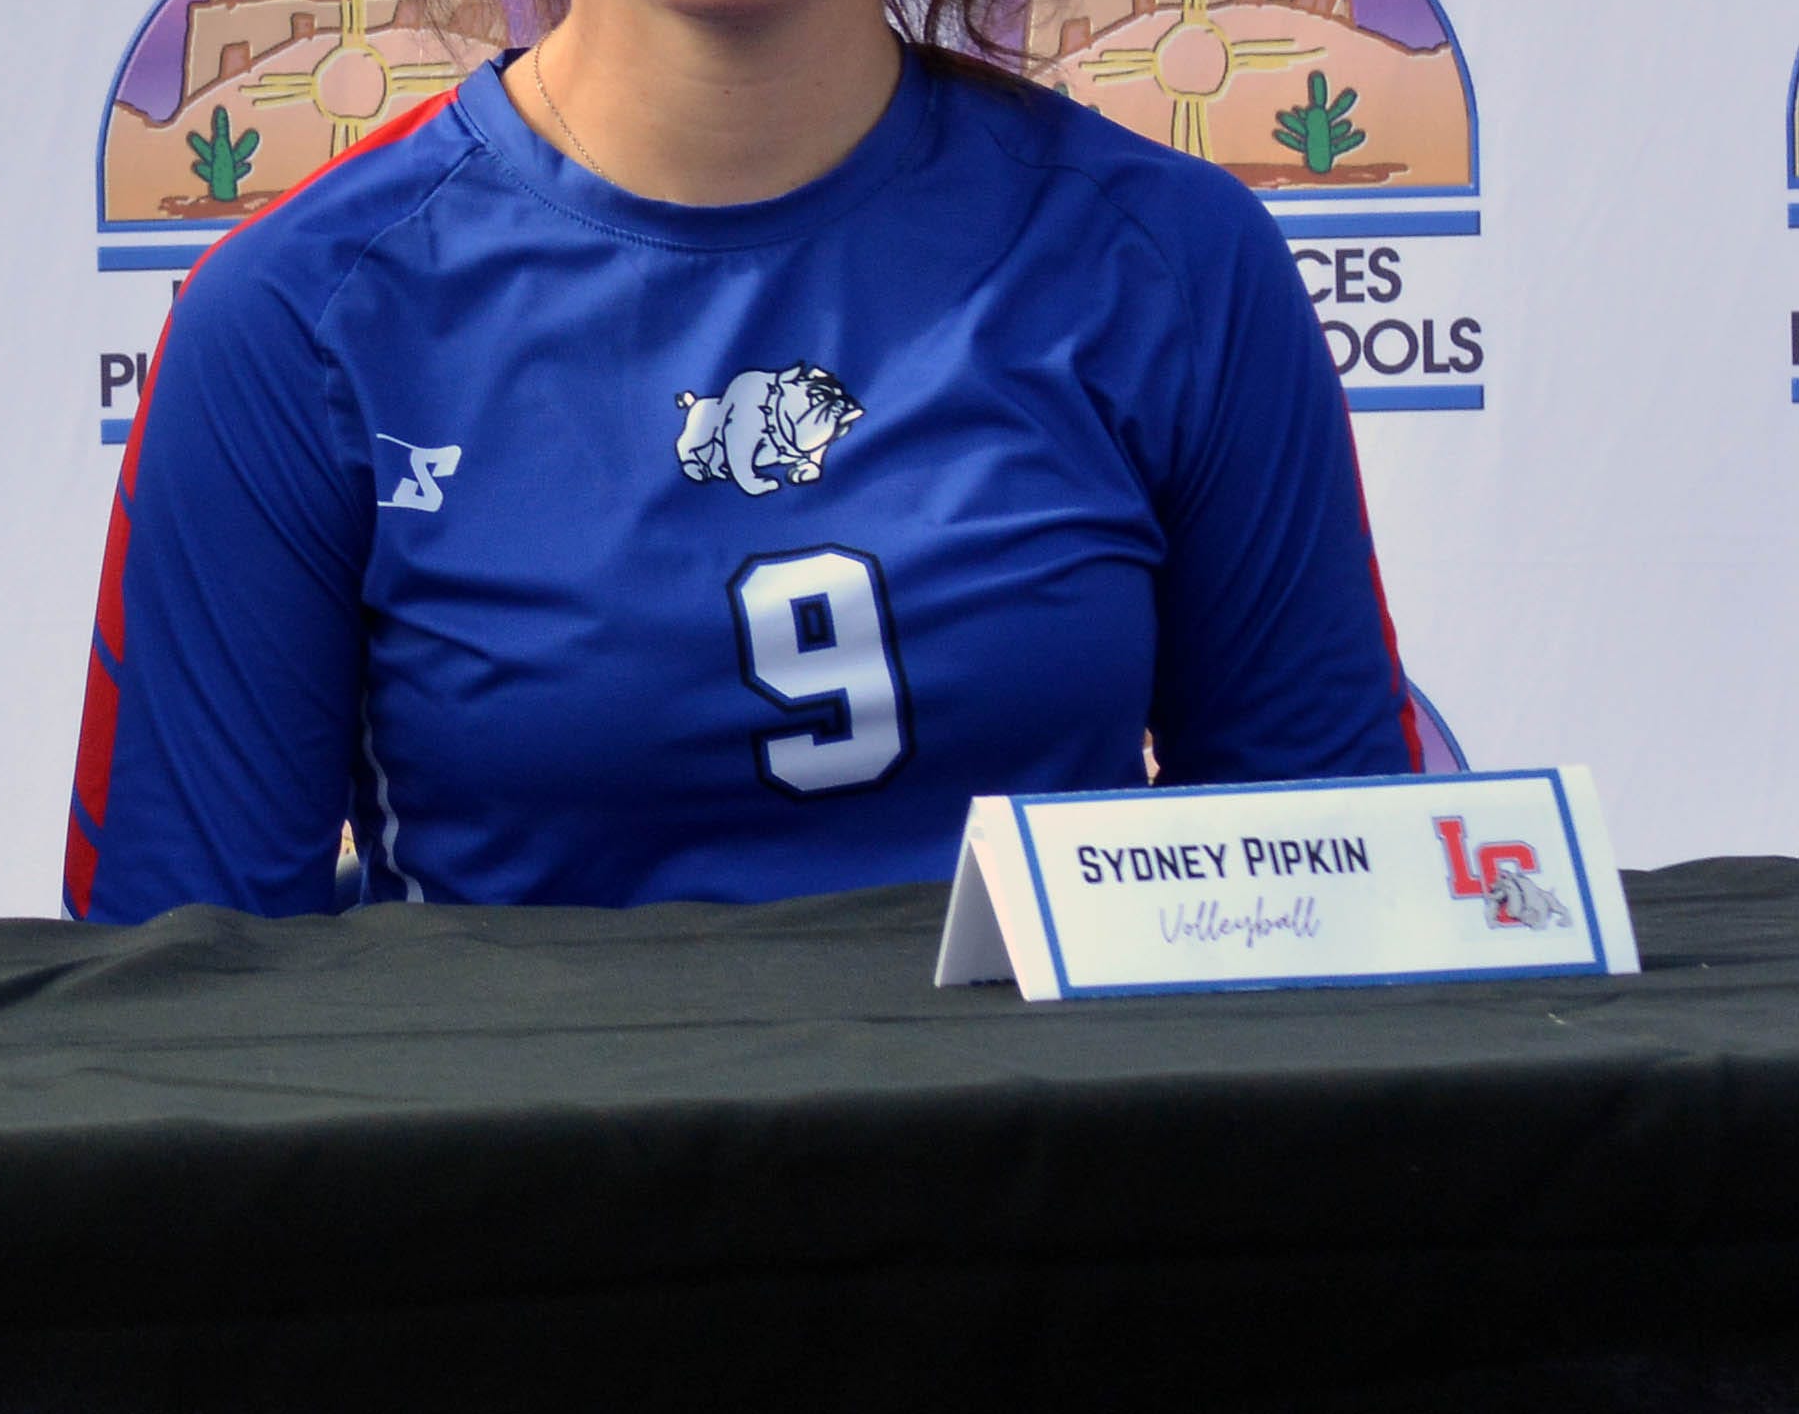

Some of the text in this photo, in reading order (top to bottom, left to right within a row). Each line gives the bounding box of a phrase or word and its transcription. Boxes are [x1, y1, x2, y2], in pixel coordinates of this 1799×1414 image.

[1293, 247, 1402, 303] CES
[1322, 317, 1483, 375] OOLS
[730, 544, 912, 799] 9
[1159, 896, 1321, 949] Volleyball
